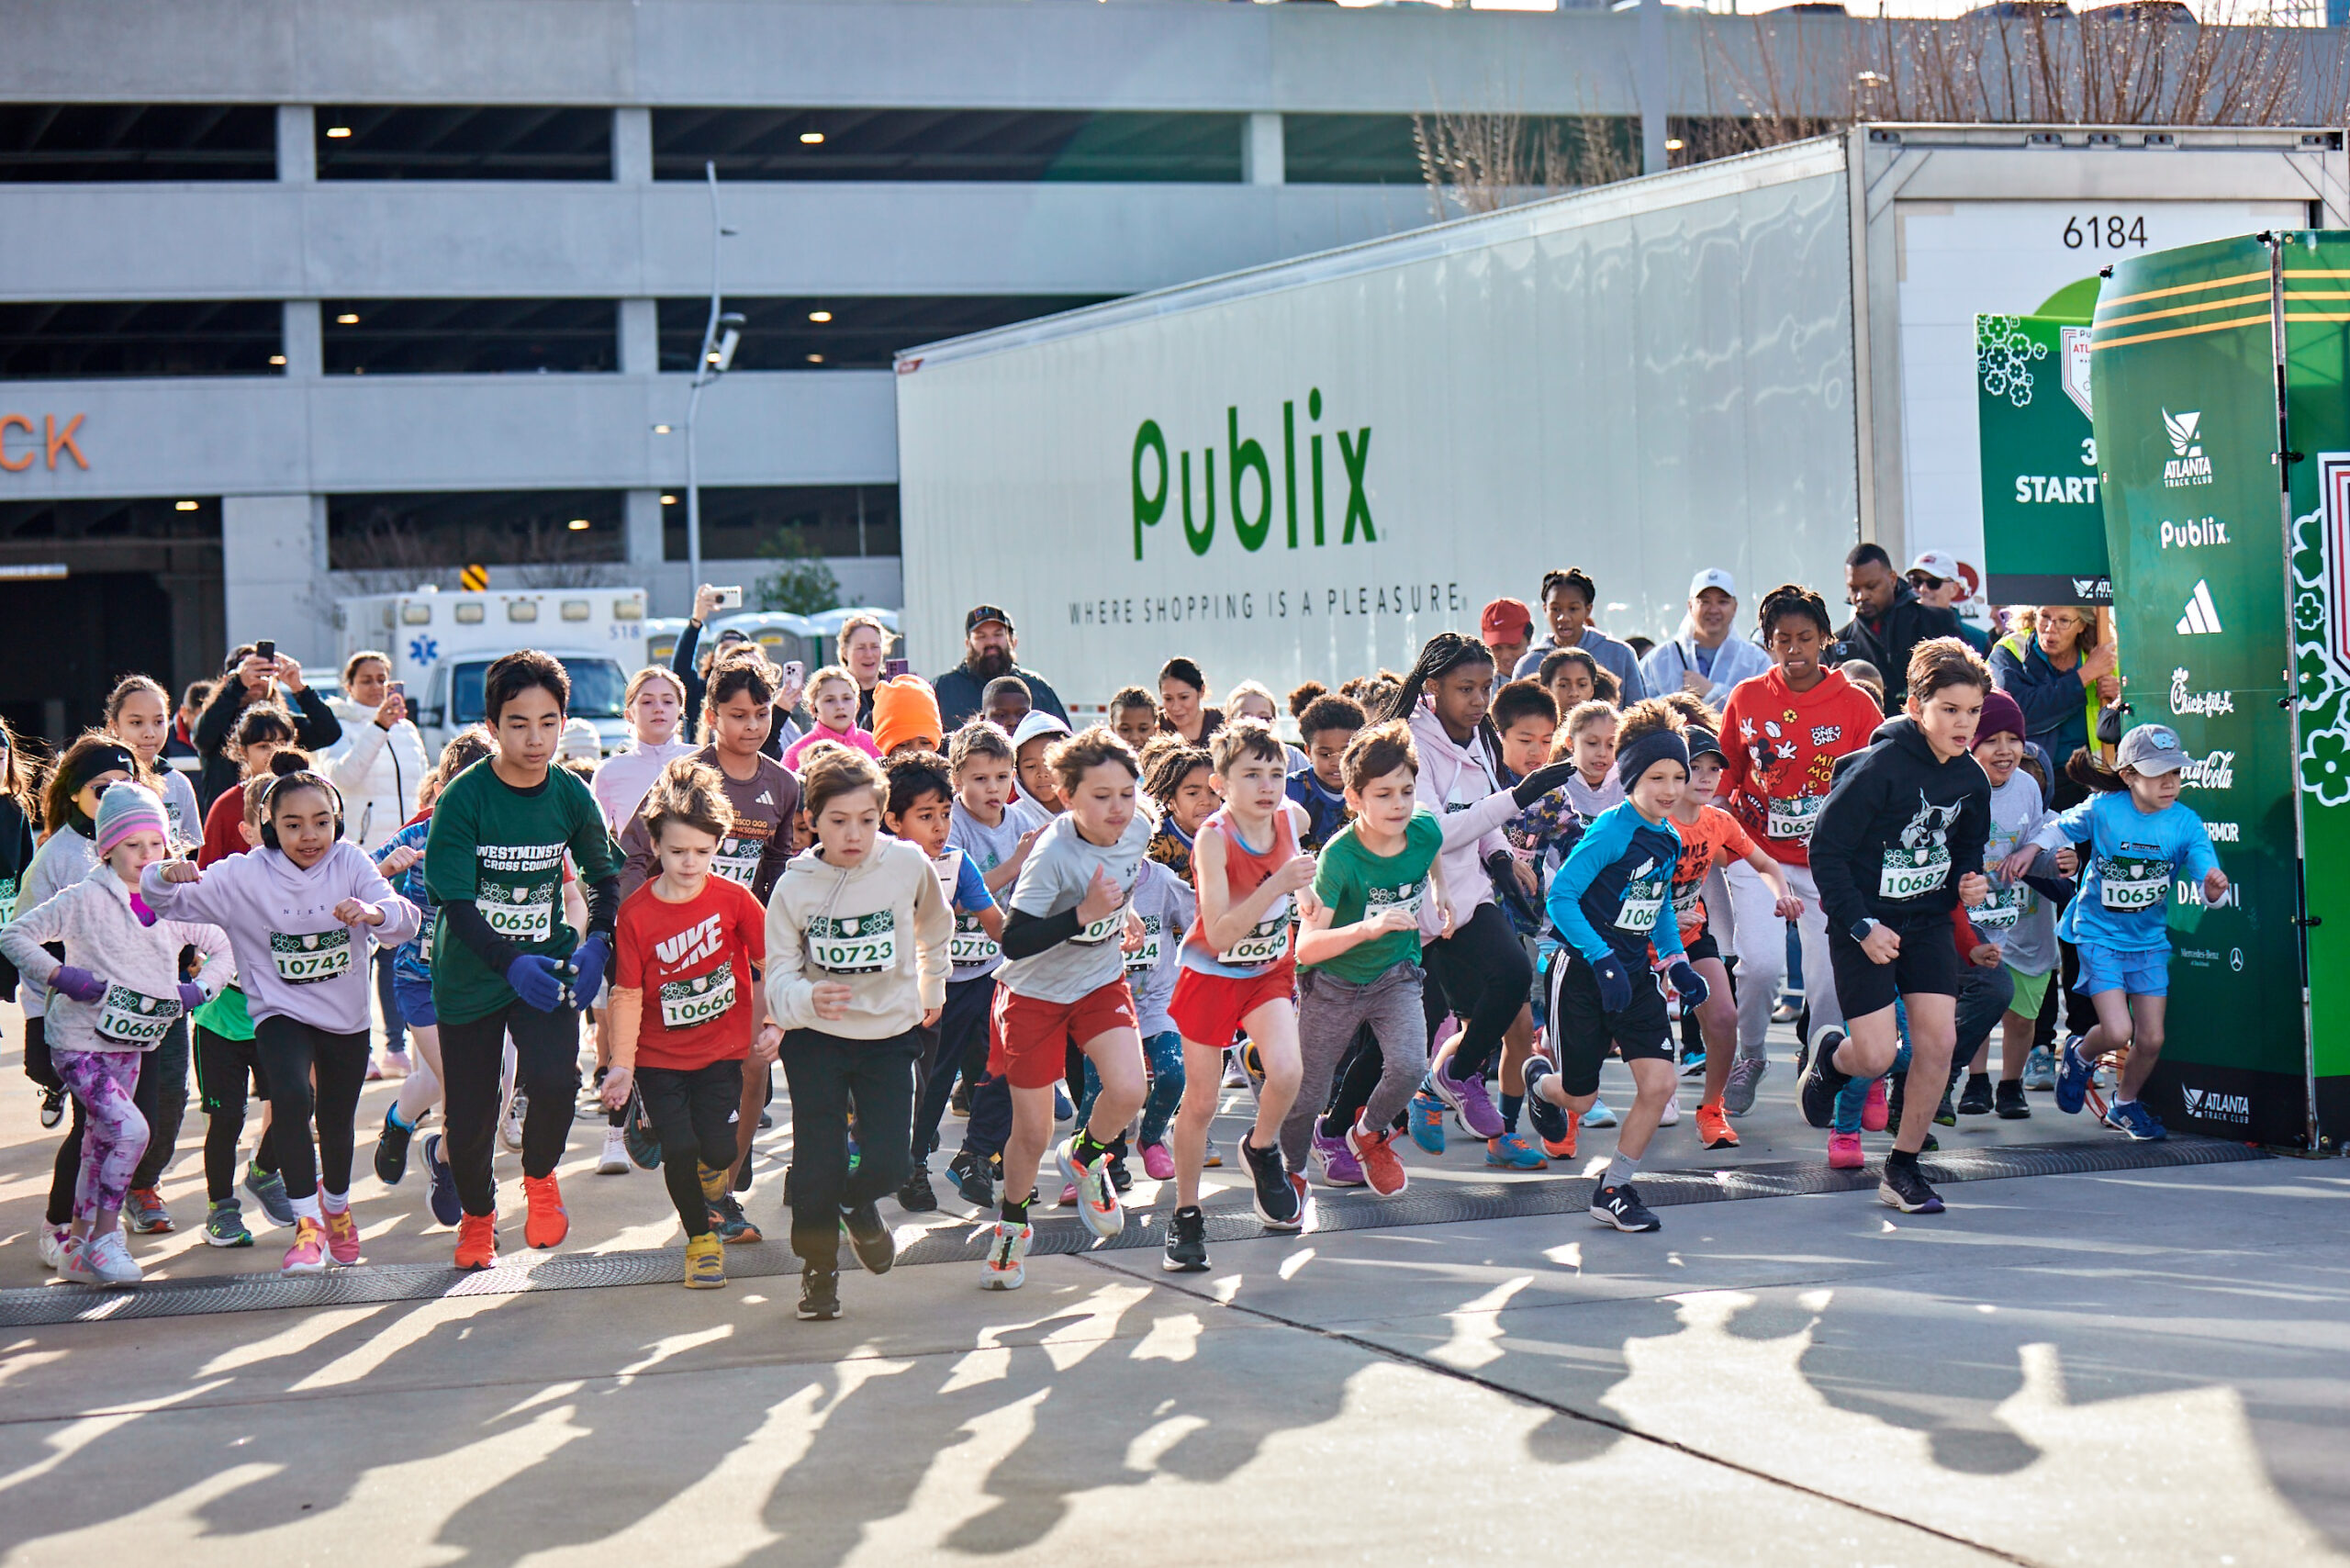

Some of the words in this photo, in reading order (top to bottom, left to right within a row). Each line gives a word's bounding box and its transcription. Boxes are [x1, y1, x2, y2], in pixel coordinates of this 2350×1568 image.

[2063, 216, 2148, 249] 6184
[0, 413, 90, 472] CK
[1132, 386, 1377, 561] Publix
[2164, 456, 2211, 479] ATLANTA
[2015, 475, 2098, 504] START
[2165, 477, 2189, 488] TRACK
[2193, 475, 2213, 486] CLUB
[2160, 516, 2227, 549] Publix
[1069, 599, 1133, 625] WHERE
[1144, 592, 1253, 623] SHOPPING
[1268, 590, 1286, 618] IS
[1302, 590, 1312, 616] A
[1328, 582, 1458, 616] PLEASURE
[610, 624, 641, 641] 518
[2170, 678, 2234, 718] Chick-fil-A
[1812, 727, 1834, 740] ONE
[1813, 731, 1841, 746] ONLY
[2180, 751, 2236, 790] oca-Cola
[483, 858, 520, 872] CROSS
[1887, 869, 1946, 893] 10687
[2107, 884, 2168, 903] 10659
[284, 904, 325, 915] NIKE
[480, 909, 548, 930] 10656
[655, 913, 723, 975] NIKE
[816, 941, 892, 964] 10723
[278, 951, 349, 975] 10742
[668, 988, 734, 1021] 10660
[104, 1014, 167, 1037] 10668
[2204, 1092, 2249, 1114] ATLANTA
[2204, 1110, 2227, 1121] TRACK
[2231, 1114, 2249, 1125] CLUB
